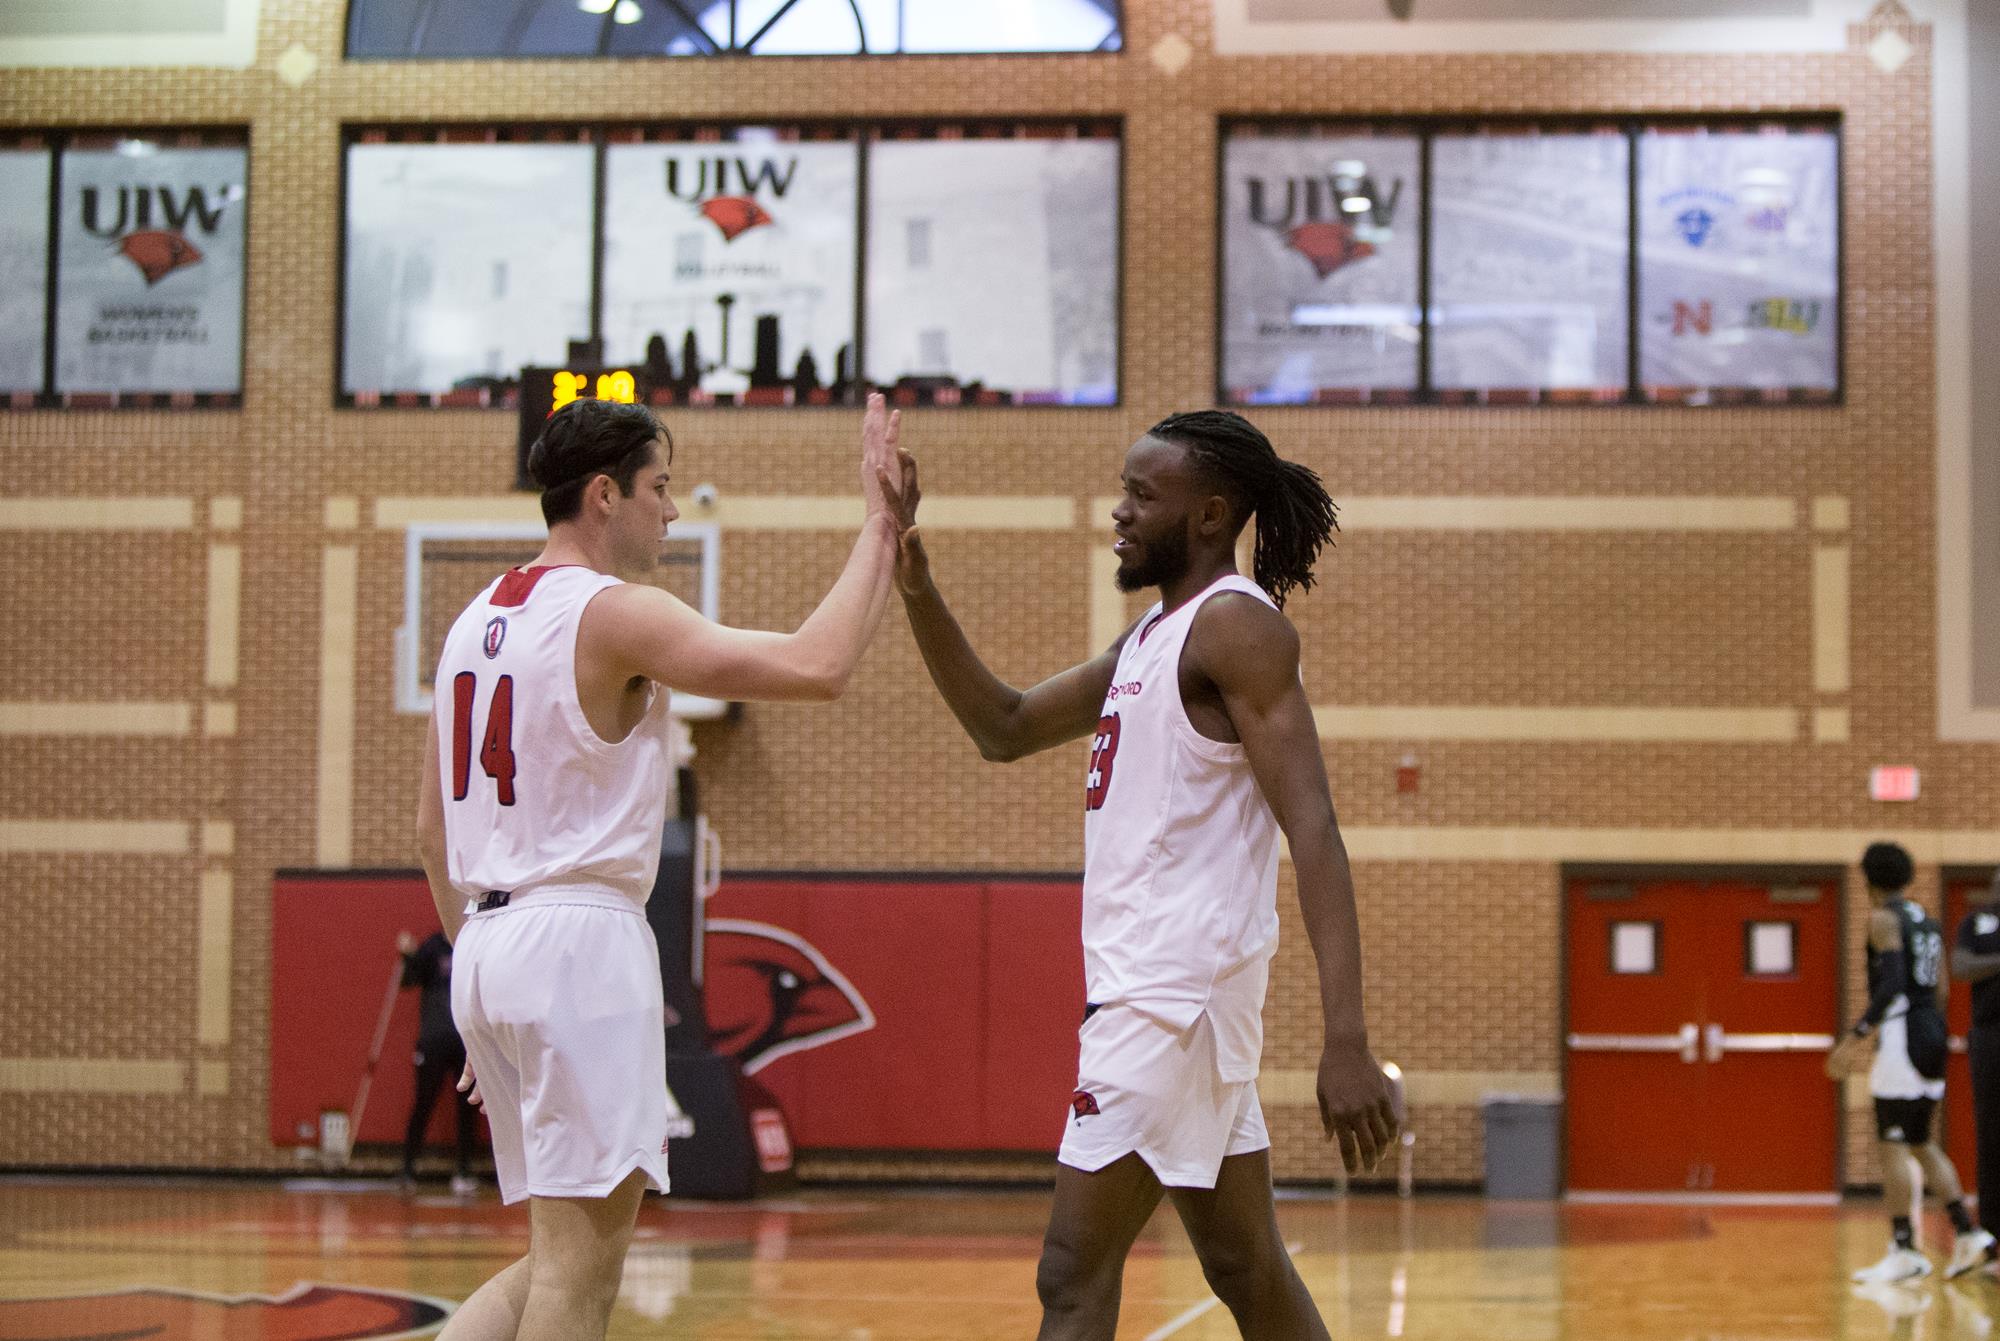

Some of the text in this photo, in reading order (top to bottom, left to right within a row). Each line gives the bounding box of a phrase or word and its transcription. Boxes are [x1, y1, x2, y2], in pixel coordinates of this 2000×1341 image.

[665, 157, 797, 201] UIW
[1248, 176, 1404, 228] UIW
[80, 185, 231, 238] UIW
[453, 671, 517, 807] 14
